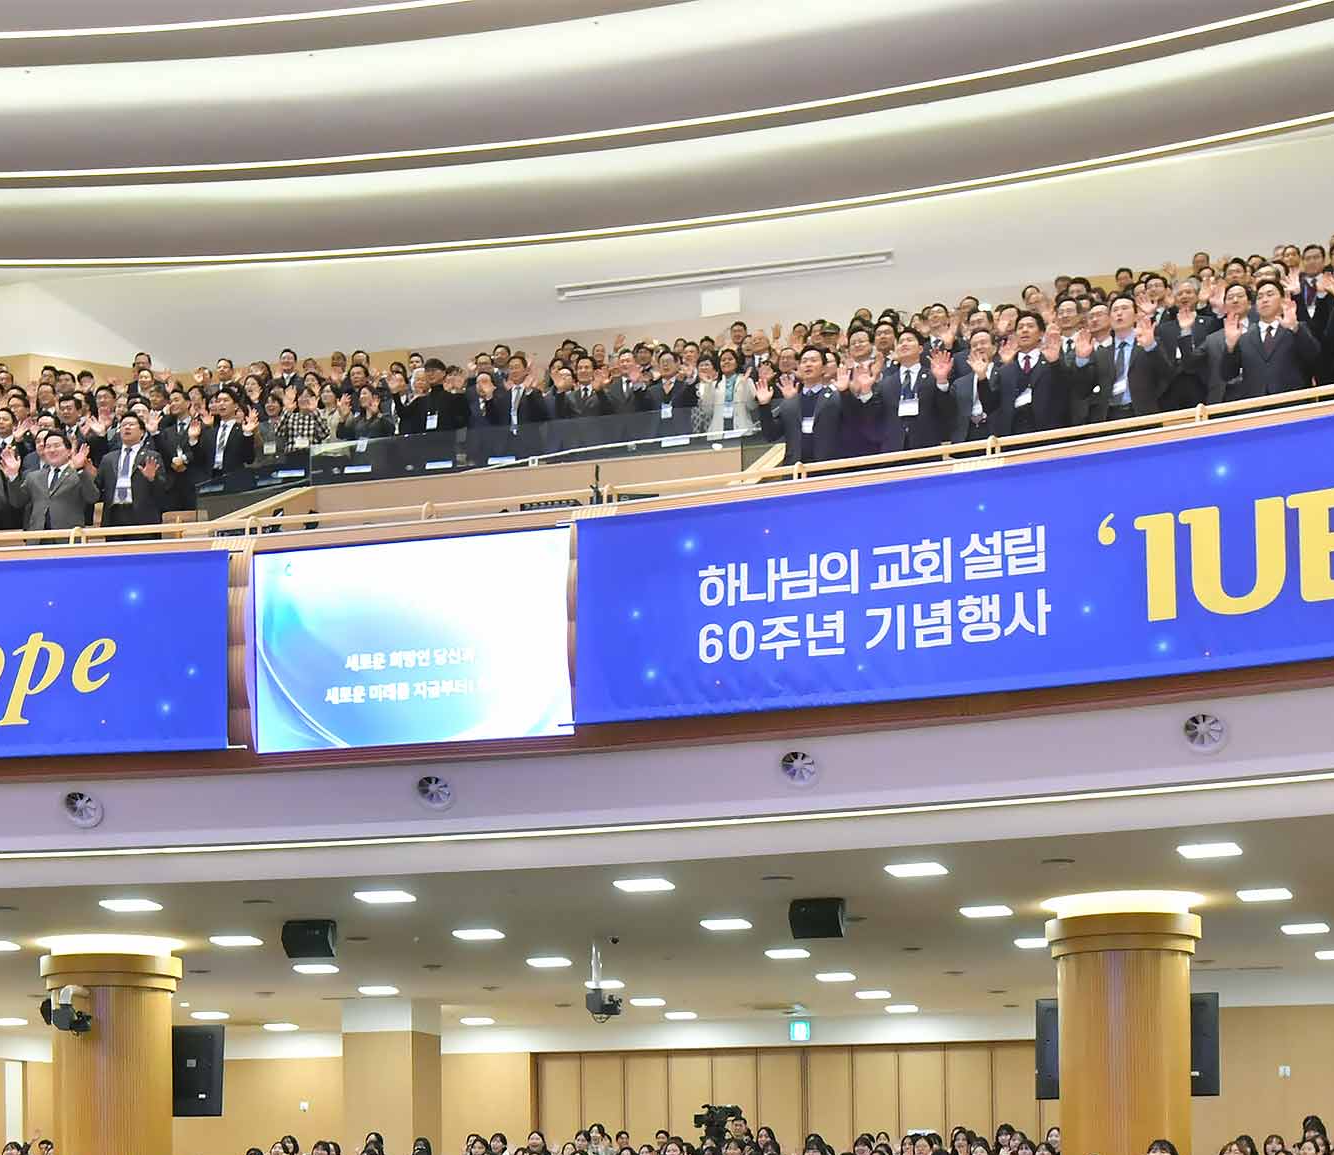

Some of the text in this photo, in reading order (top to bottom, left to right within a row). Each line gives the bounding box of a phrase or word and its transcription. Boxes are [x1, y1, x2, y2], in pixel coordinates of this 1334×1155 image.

[698, 525, 1046, 608] 하나님의 교회 설립
[698, 610, 845, 665] 60주년
